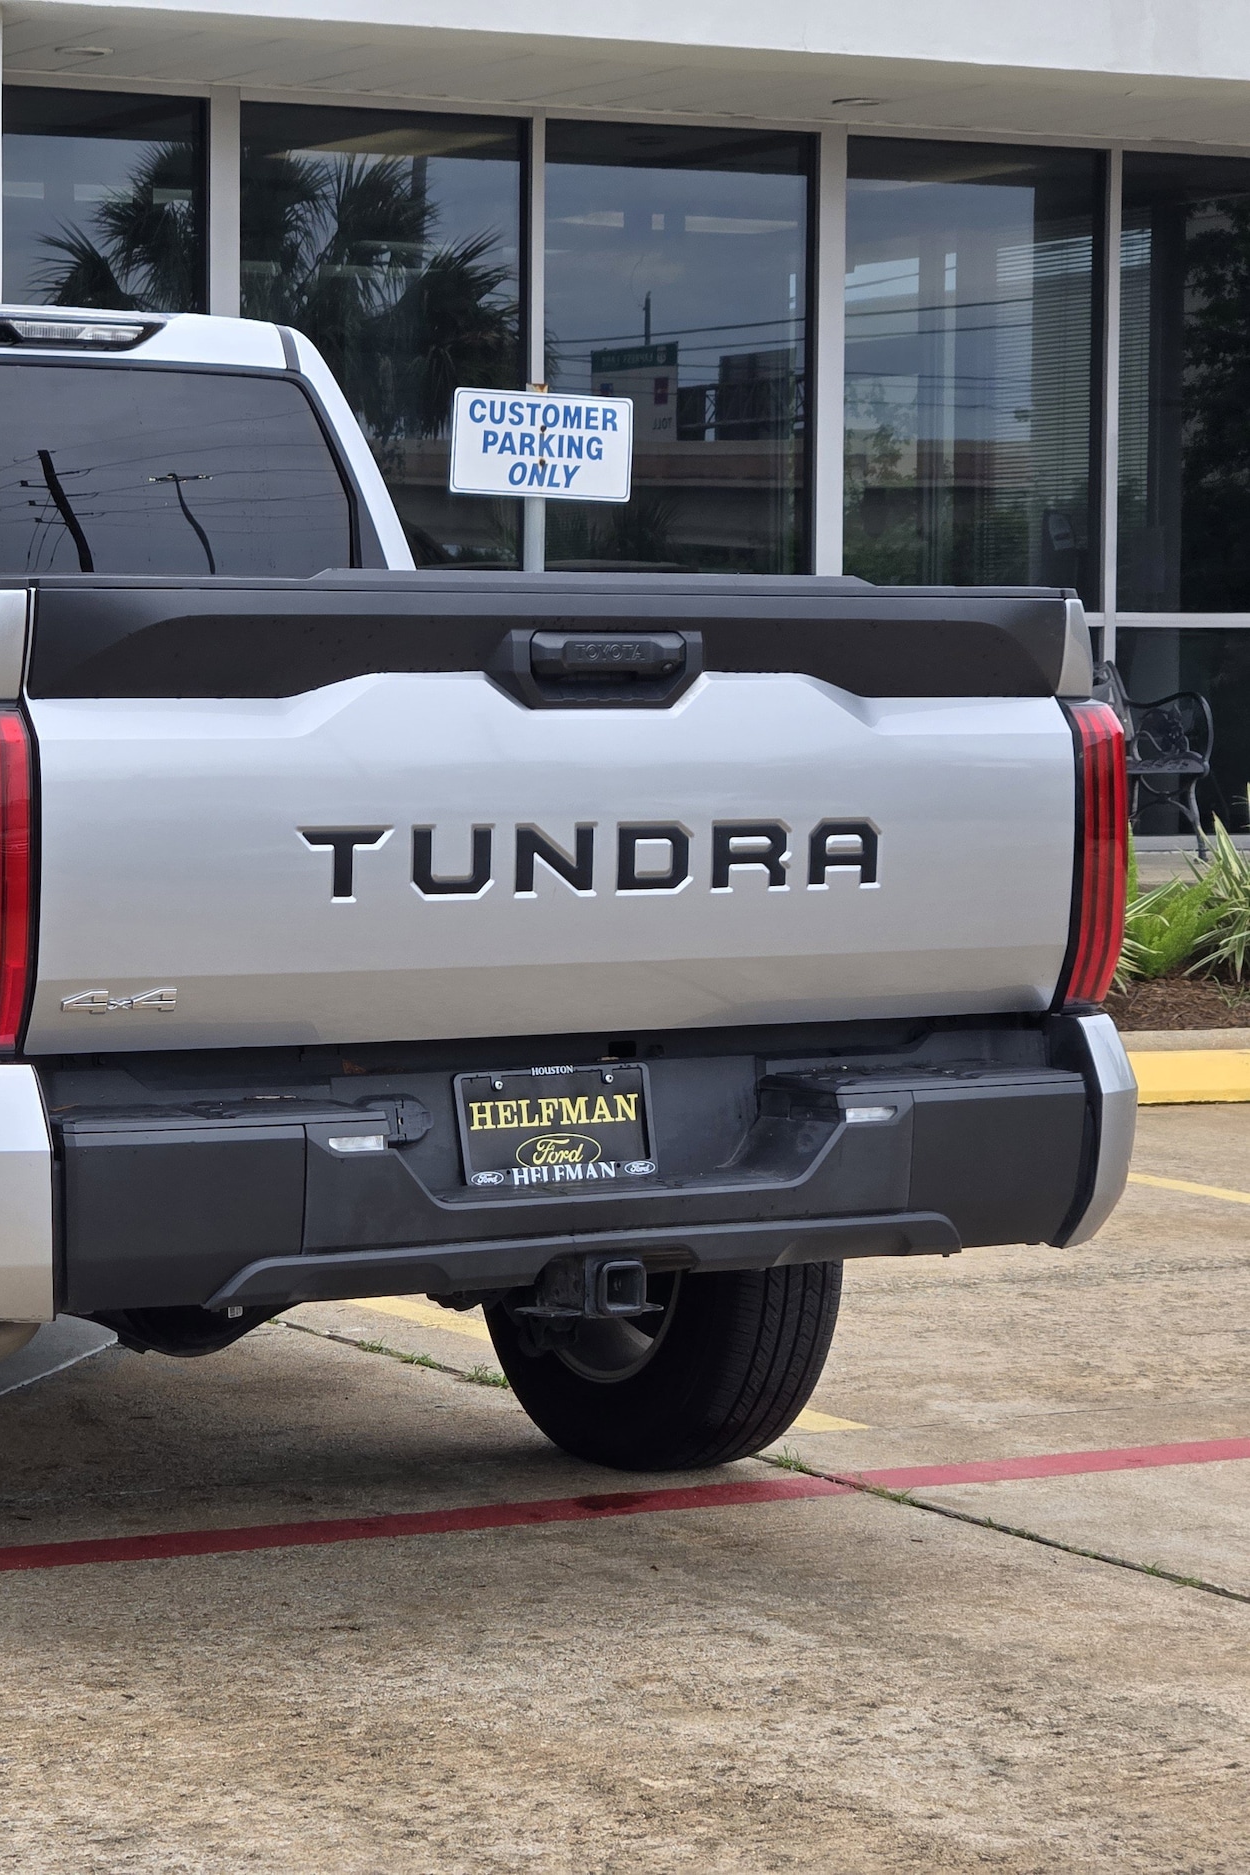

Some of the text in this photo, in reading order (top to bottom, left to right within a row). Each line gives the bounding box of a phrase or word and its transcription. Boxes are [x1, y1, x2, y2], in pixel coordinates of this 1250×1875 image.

[468, 398, 619, 432] CUSTOMER
[482, 430, 603, 461] PARKING
[508, 461, 581, 489] ONLY
[574, 643, 646, 661] TOYOTA
[296, 816, 881, 903] TUNDRA
[531, 1065, 574, 1076] HOUSTON
[469, 1093, 639, 1131] HELFMAN
[532, 1138, 585, 1165] Ford
[476, 1173, 500, 1184] Ford
[629, 1162, 651, 1173] Ford
